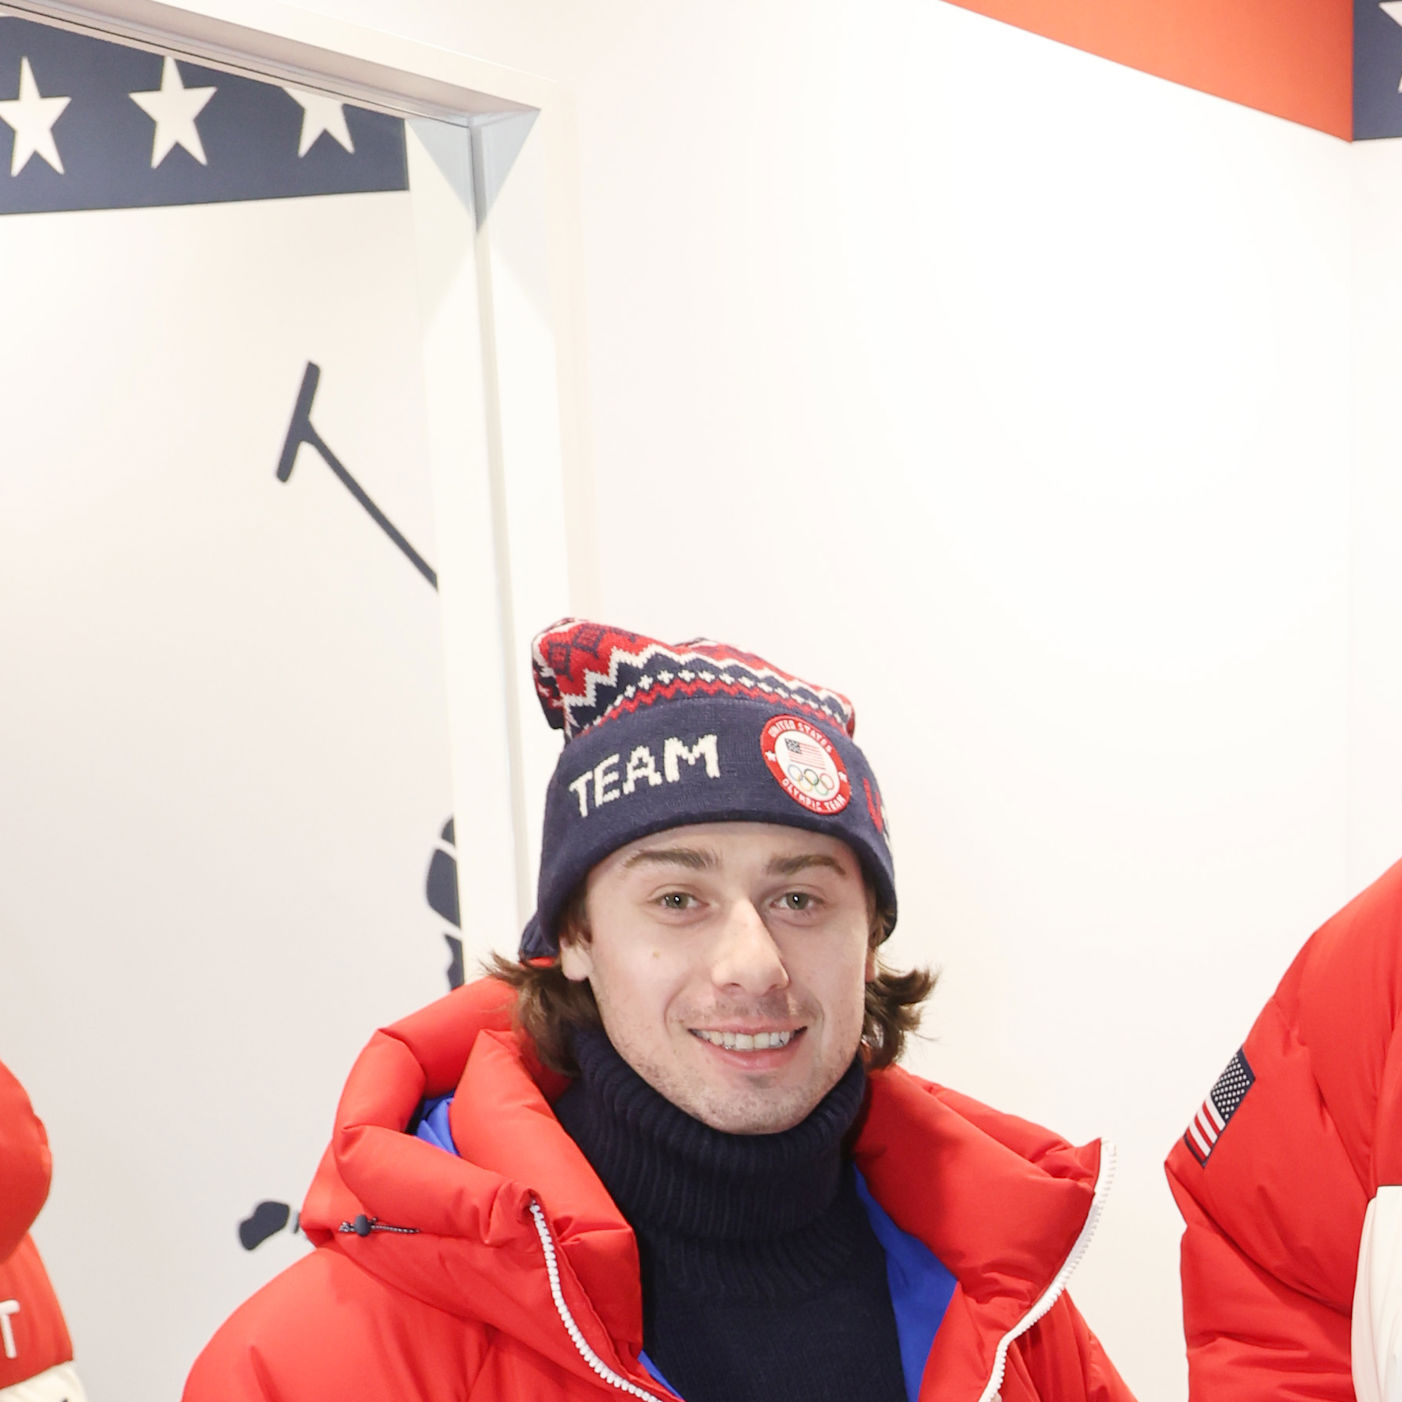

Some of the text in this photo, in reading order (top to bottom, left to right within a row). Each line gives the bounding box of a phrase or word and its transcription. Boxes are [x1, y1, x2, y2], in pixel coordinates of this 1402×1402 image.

[768, 719, 796, 738] UNITED
[568, 733, 721, 818] TEAM
[781, 778, 847, 812] OLYMPIC TEAM
